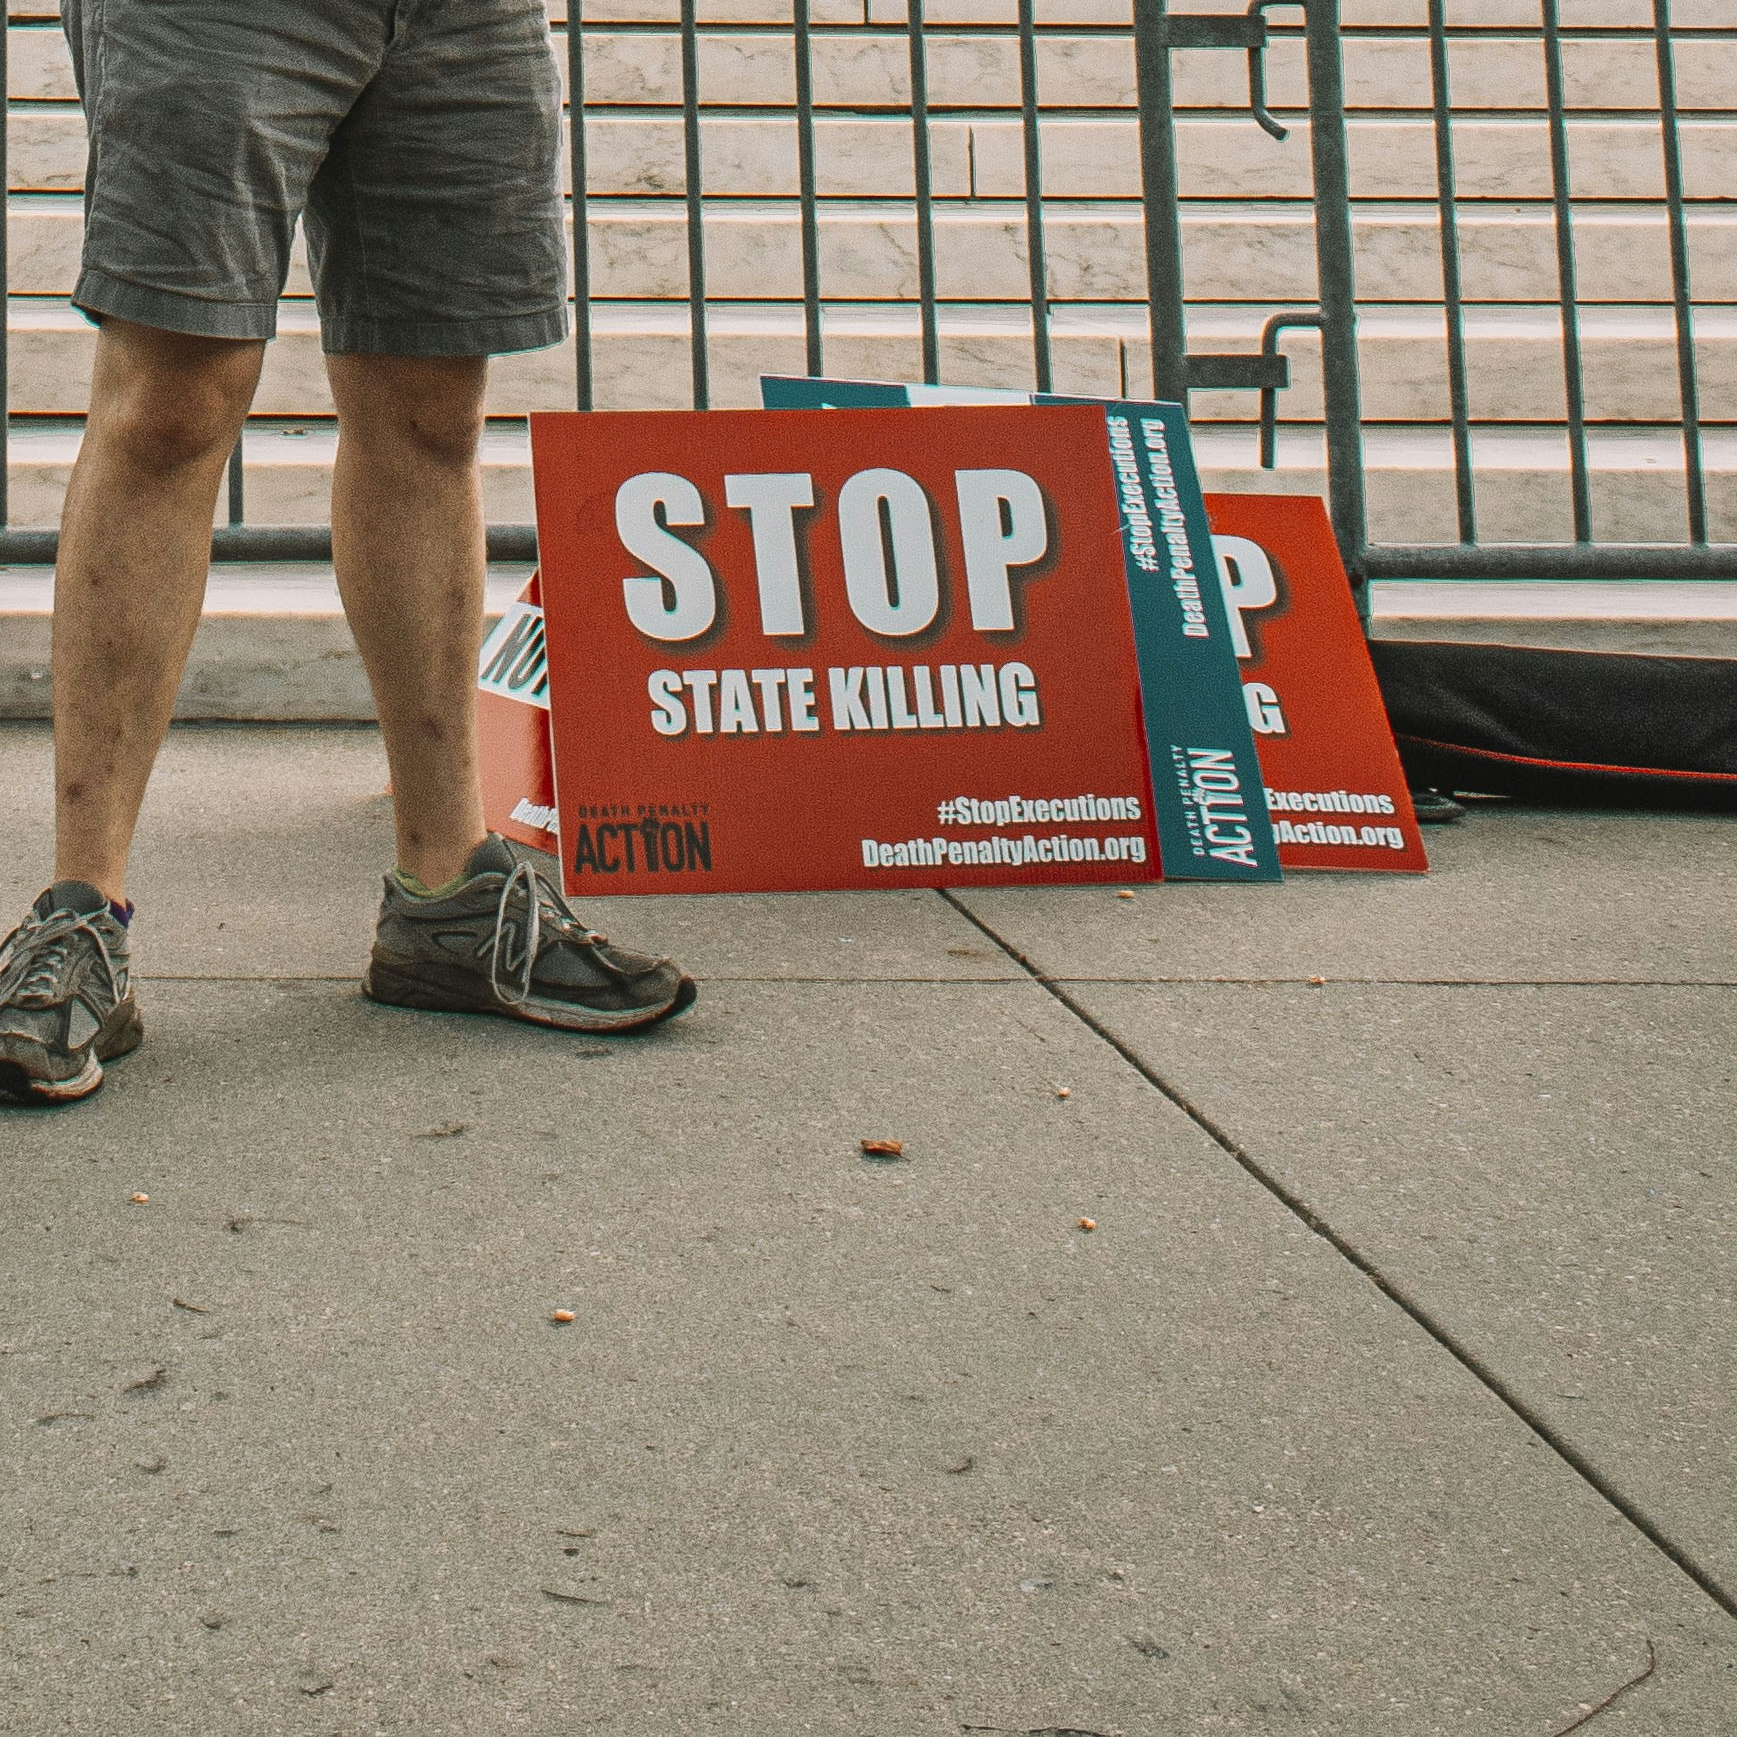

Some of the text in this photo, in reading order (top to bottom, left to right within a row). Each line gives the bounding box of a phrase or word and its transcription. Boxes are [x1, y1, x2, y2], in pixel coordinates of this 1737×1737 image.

[1107, 415, 1160, 573] #StopExecutions
[1140, 418, 1209, 639] DeathPenaltyAction.org
[614, 466, 1049, 642] STOP
[647, 662, 1041, 736] STATE KILLING
[937, 794, 1141, 827] #StopExecutions
[1170, 744, 1205, 857] DEATH PENALTY
[1263, 787, 1395, 815] Executions
[574, 819, 712, 874] ACTION
[861, 835, 1146, 868] DeathPenaltyAction.org
